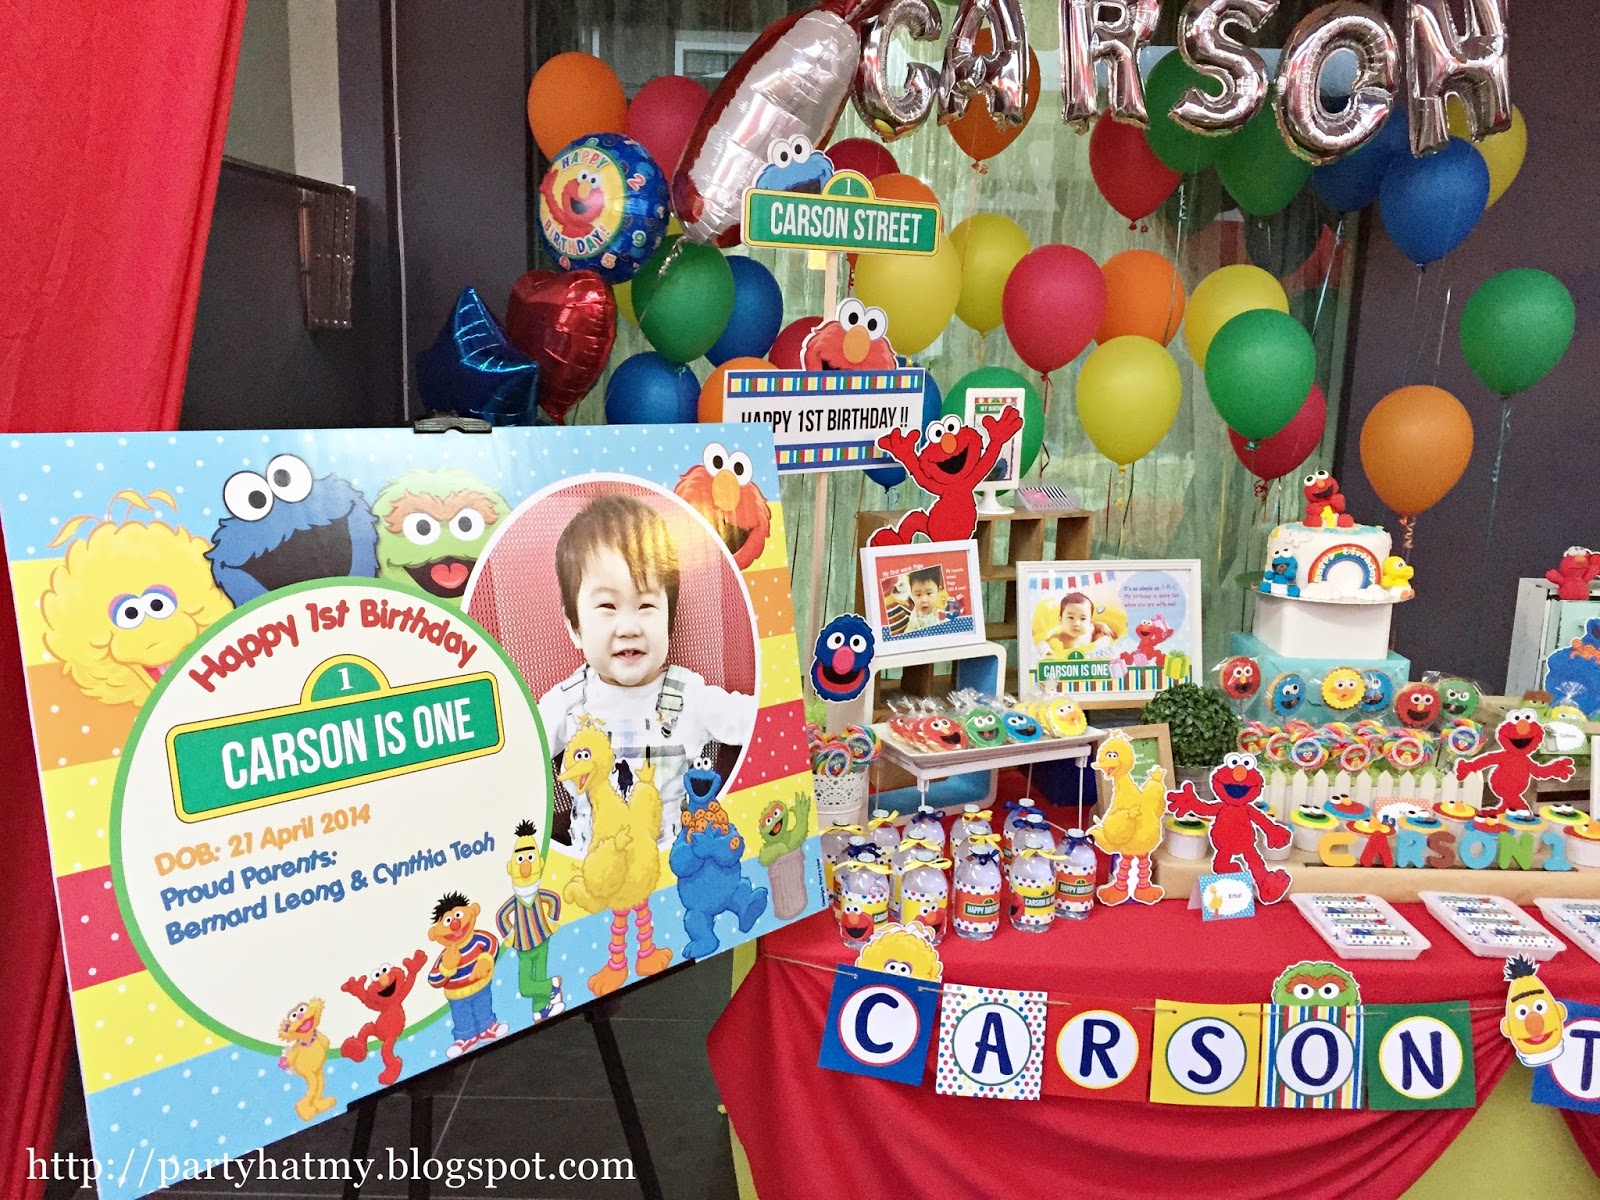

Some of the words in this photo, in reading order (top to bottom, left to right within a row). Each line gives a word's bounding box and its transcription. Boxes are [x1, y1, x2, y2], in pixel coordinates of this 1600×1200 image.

[561, 147, 610, 171] HAPPY
[844, 178, 852, 196] 1
[544, 220, 611, 255] BIRTHDAY!
[770, 202, 849, 239] CARSON
[853, 208, 922, 244] STREET
[798, 410, 823, 432] 1ST
[827, 407, 897, 431] BIRTHDAY
[188, 614, 299, 693] Happy
[305, 599, 350, 632] 1st
[360, 598, 477, 669] Birthday
[337, 667, 353, 691] 1
[1043, 664, 1079, 677] CARSON
[1081, 664, 1089, 676] IS
[1091, 663, 1108, 676] ONE
[221, 717, 369, 790] CARSON
[374, 710, 406, 759] IS
[413, 697, 475, 749] ONE
[154, 842, 220, 877] DOB:
[228, 829, 253, 857] 21
[260, 816, 314, 854] April
[320, 803, 371, 834] 2014
[1318, 829, 1534, 870] CARSON
[160, 872, 236, 912] Proud
[242, 849, 338, 891] Parents:
[165, 902, 269, 946] Bernard
[274, 879, 346, 917] Leong
[350, 870, 368, 889] &
[372, 847, 448, 889] Cynthia
[450, 831, 495, 863] Teoh
[1060, 883, 1076, 893] HAPPY
[967, 904, 984, 914] HAPPY
[855, 992, 1444, 1091] CARSON
